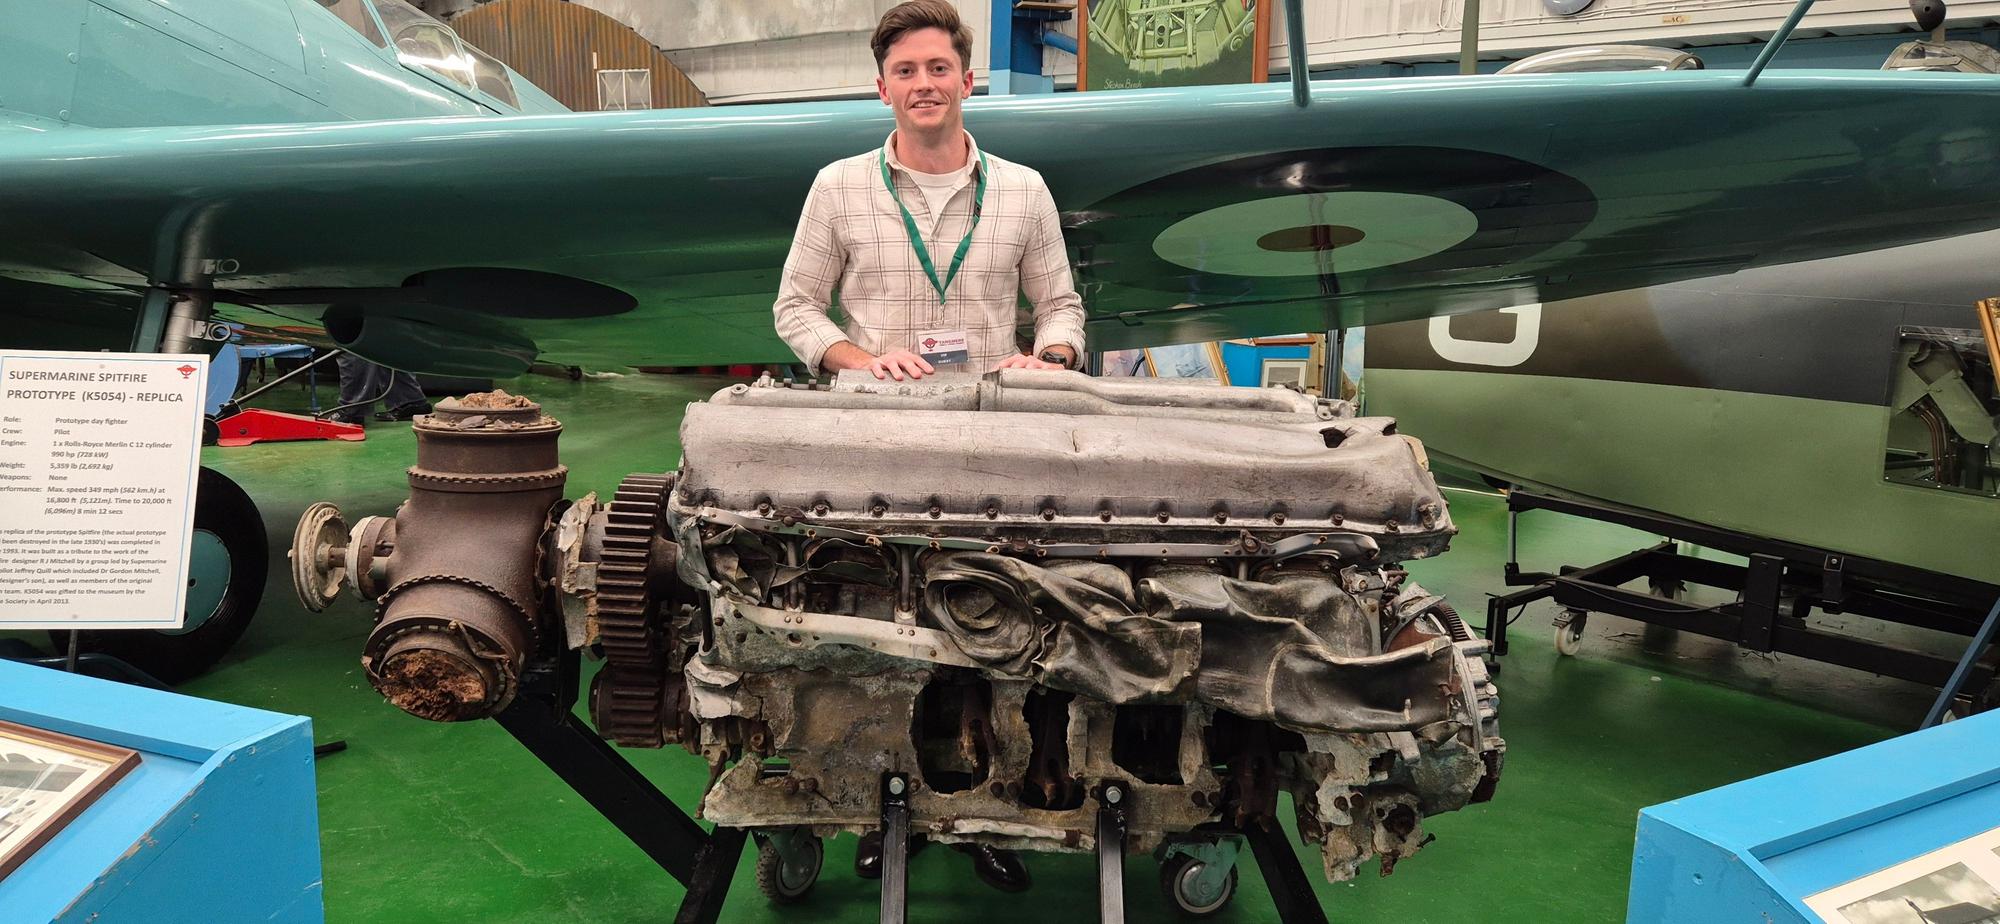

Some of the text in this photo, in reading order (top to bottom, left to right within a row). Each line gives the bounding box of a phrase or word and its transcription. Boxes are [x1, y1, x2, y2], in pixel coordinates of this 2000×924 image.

[9, 371, 148, 382] SUPERMARINE SPITFIRE
[7, 390, 76, 400] PROTOTYPE
[82, 391, 126, 402] (K5054)
[136, 393, 183, 402] REPLICA
